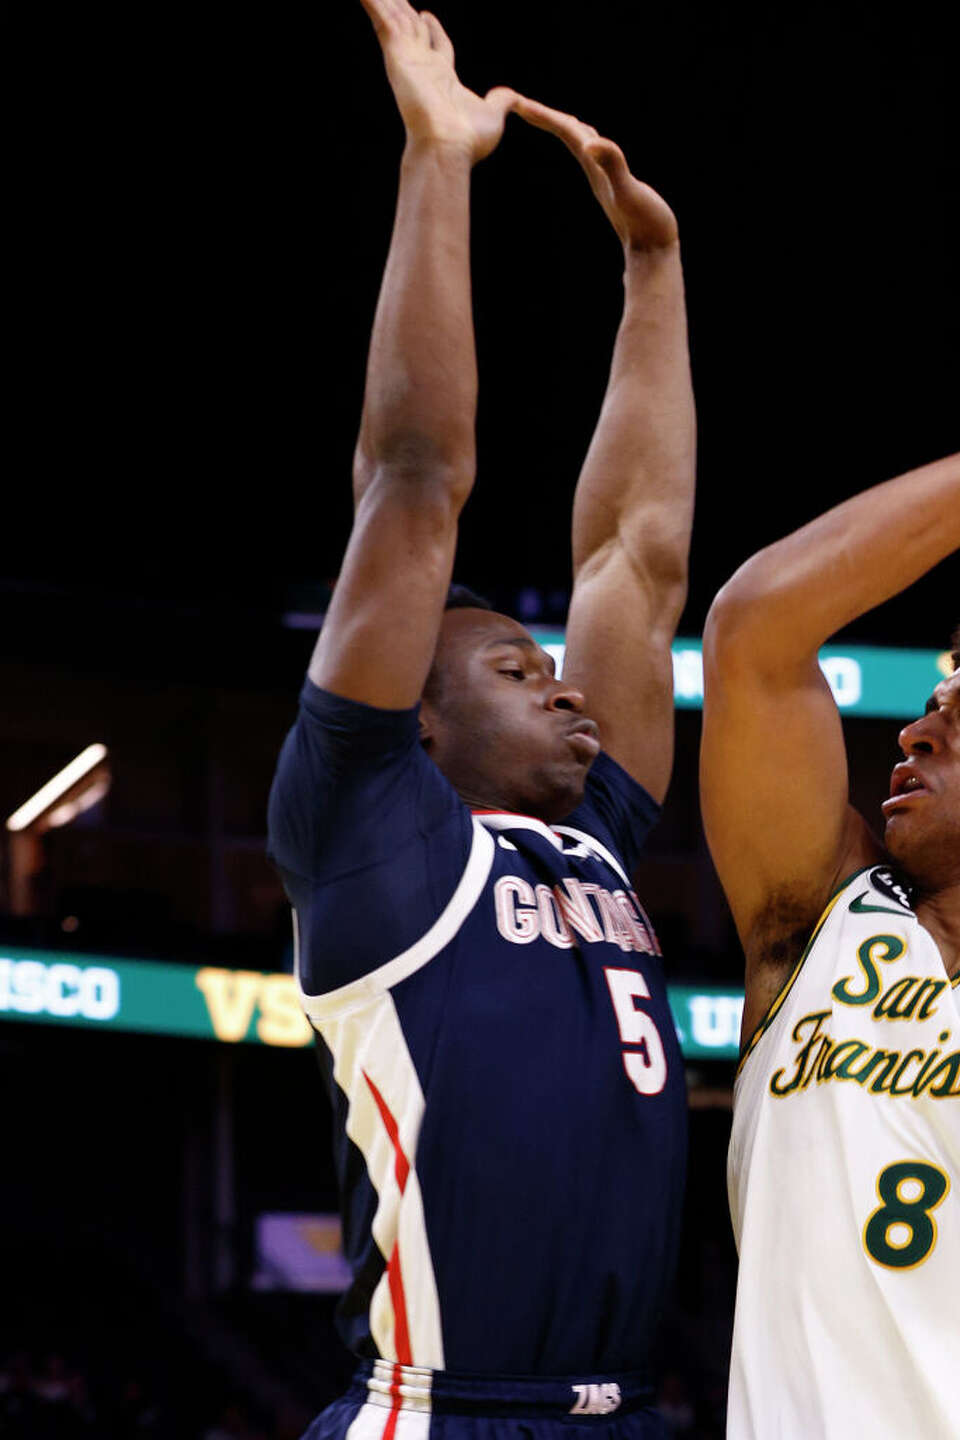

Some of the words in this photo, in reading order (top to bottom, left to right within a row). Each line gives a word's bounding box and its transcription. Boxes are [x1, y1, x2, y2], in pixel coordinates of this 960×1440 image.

[196, 966, 315, 1048] VS
[831, 933, 952, 1022] San
[602, 965, 668, 1096] 5
[862, 1158, 951, 1272] 8
